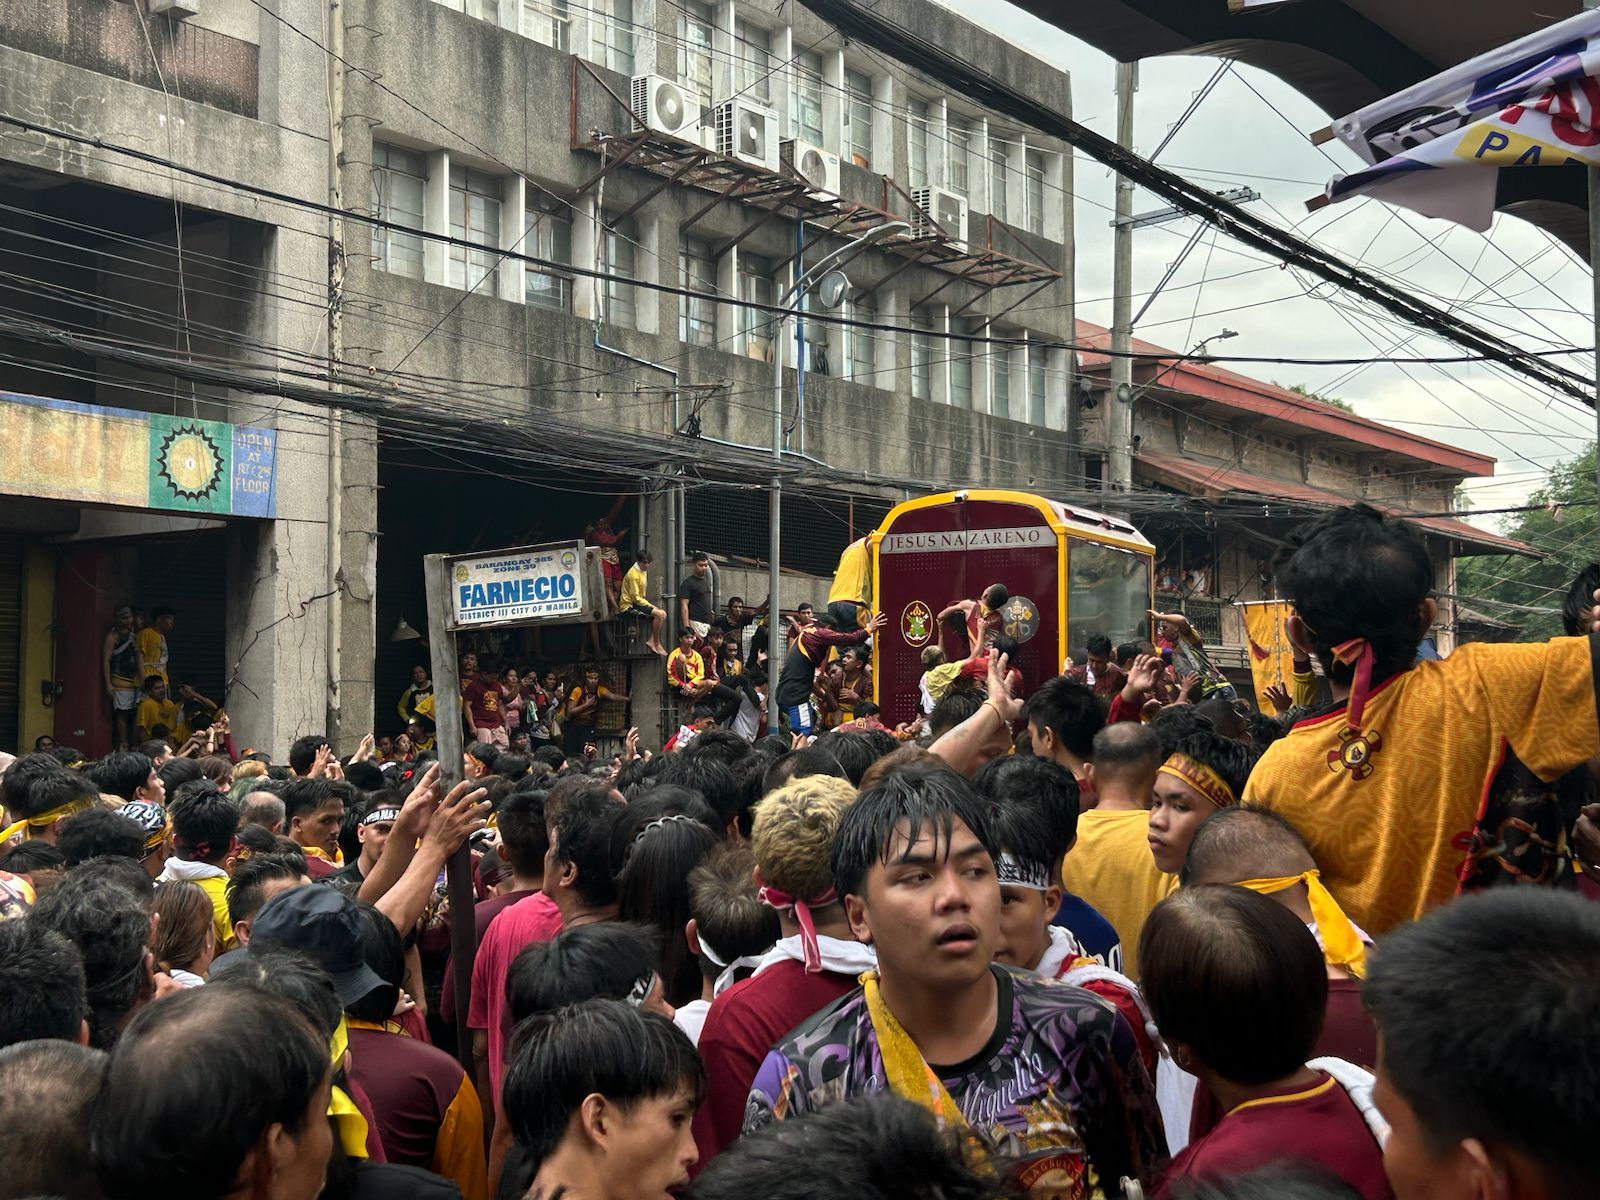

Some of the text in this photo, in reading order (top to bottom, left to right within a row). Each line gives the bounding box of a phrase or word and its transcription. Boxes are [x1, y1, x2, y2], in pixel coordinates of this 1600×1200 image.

[1474, 130, 1586, 167] PA
[238, 433, 272, 452] OPEN
[247, 452, 261, 463] AT
[235, 477, 270, 495] FLOOR
[889, 529, 1040, 552] JESUS NAZARENO
[475, 559, 532, 570] BARANGAY
[493, 565, 521, 573] ZONE
[460, 573, 575, 608] FARNECIO
[460, 609, 496, 621] DISTRICT
[511, 606, 529, 615] CITY
[546, 601, 578, 612] MANILA
